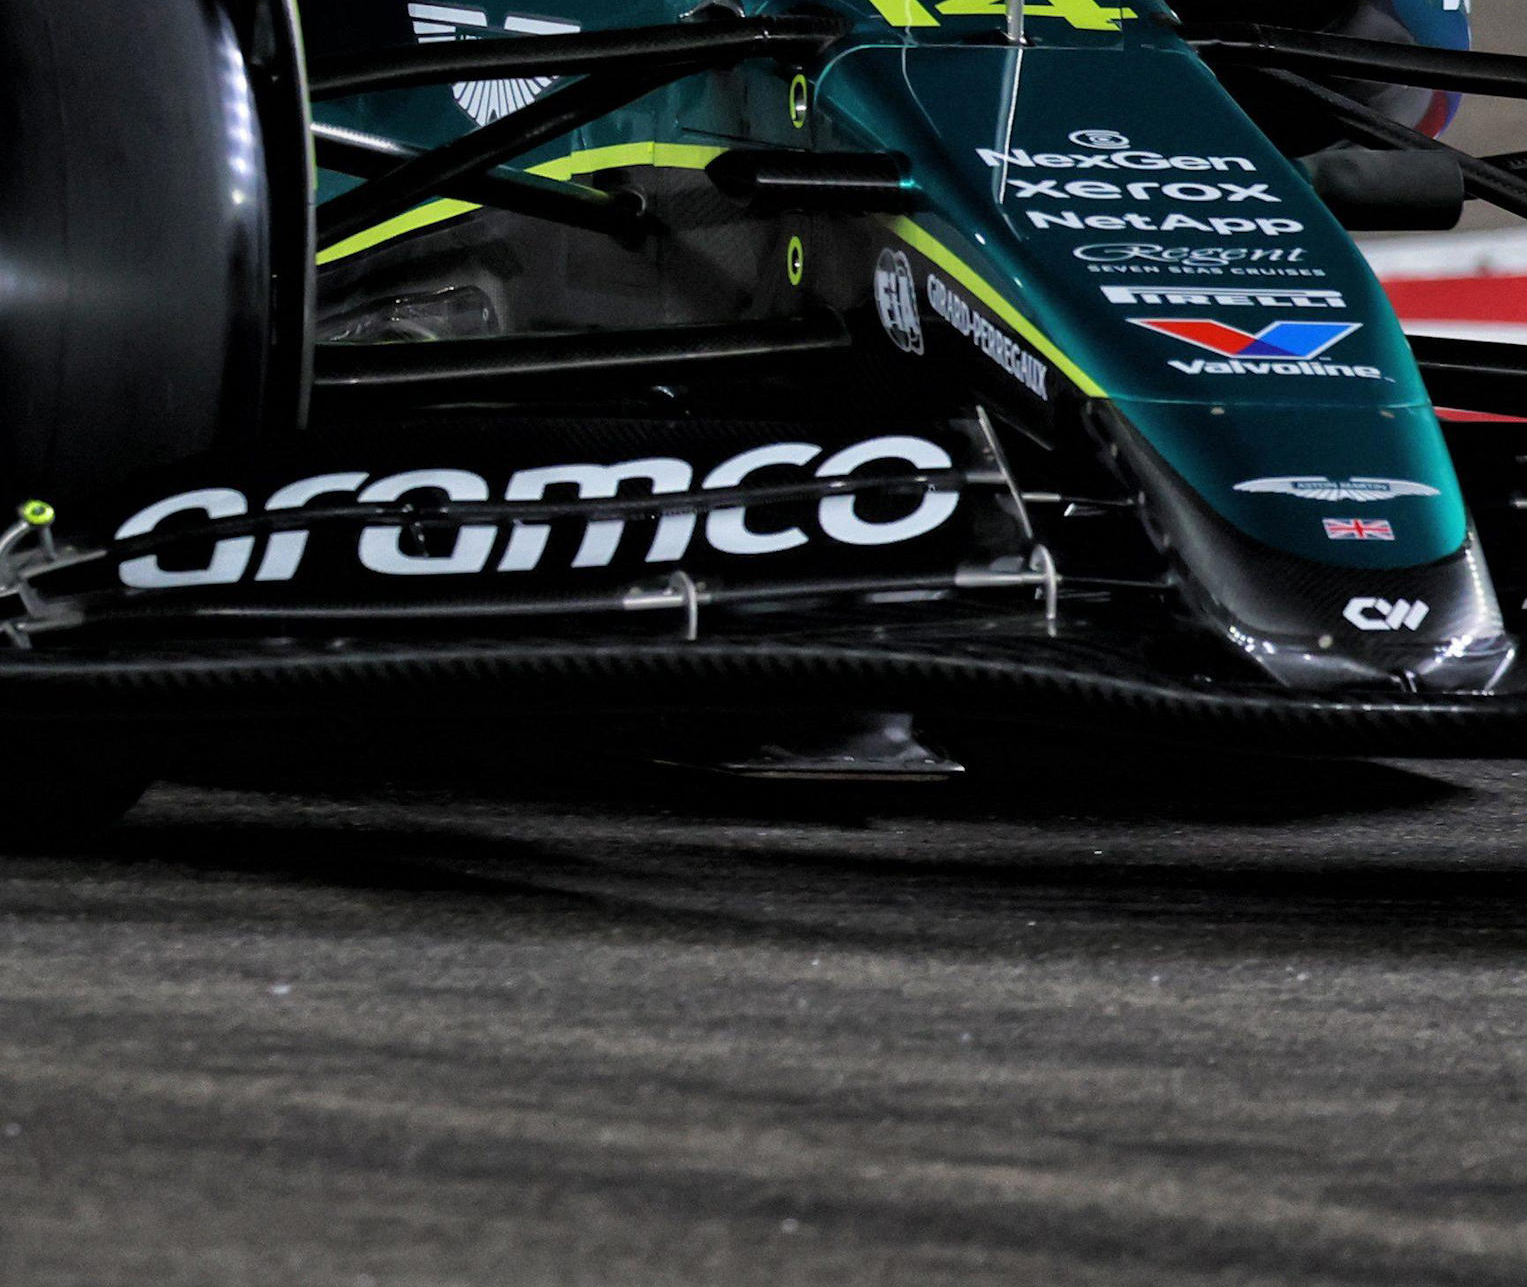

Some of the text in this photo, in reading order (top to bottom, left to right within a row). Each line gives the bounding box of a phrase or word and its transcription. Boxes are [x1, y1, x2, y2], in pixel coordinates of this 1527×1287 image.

[975, 148, 1257, 173] NexGen
[1005, 178, 1283, 203] xerox
[1025, 210, 1305, 236] NetApp
[1072, 242, 1310, 267] Regent
[1087, 264, 1327, 278] SEVEN SEAS CRUISES
[1100, 285, 1347, 308] PIRELLI
[927, 273, 1049, 401] GIRARD-PERREGAUX
[1167, 359, 1382, 380] Valvoline
[117, 435, 960, 590] aramco
